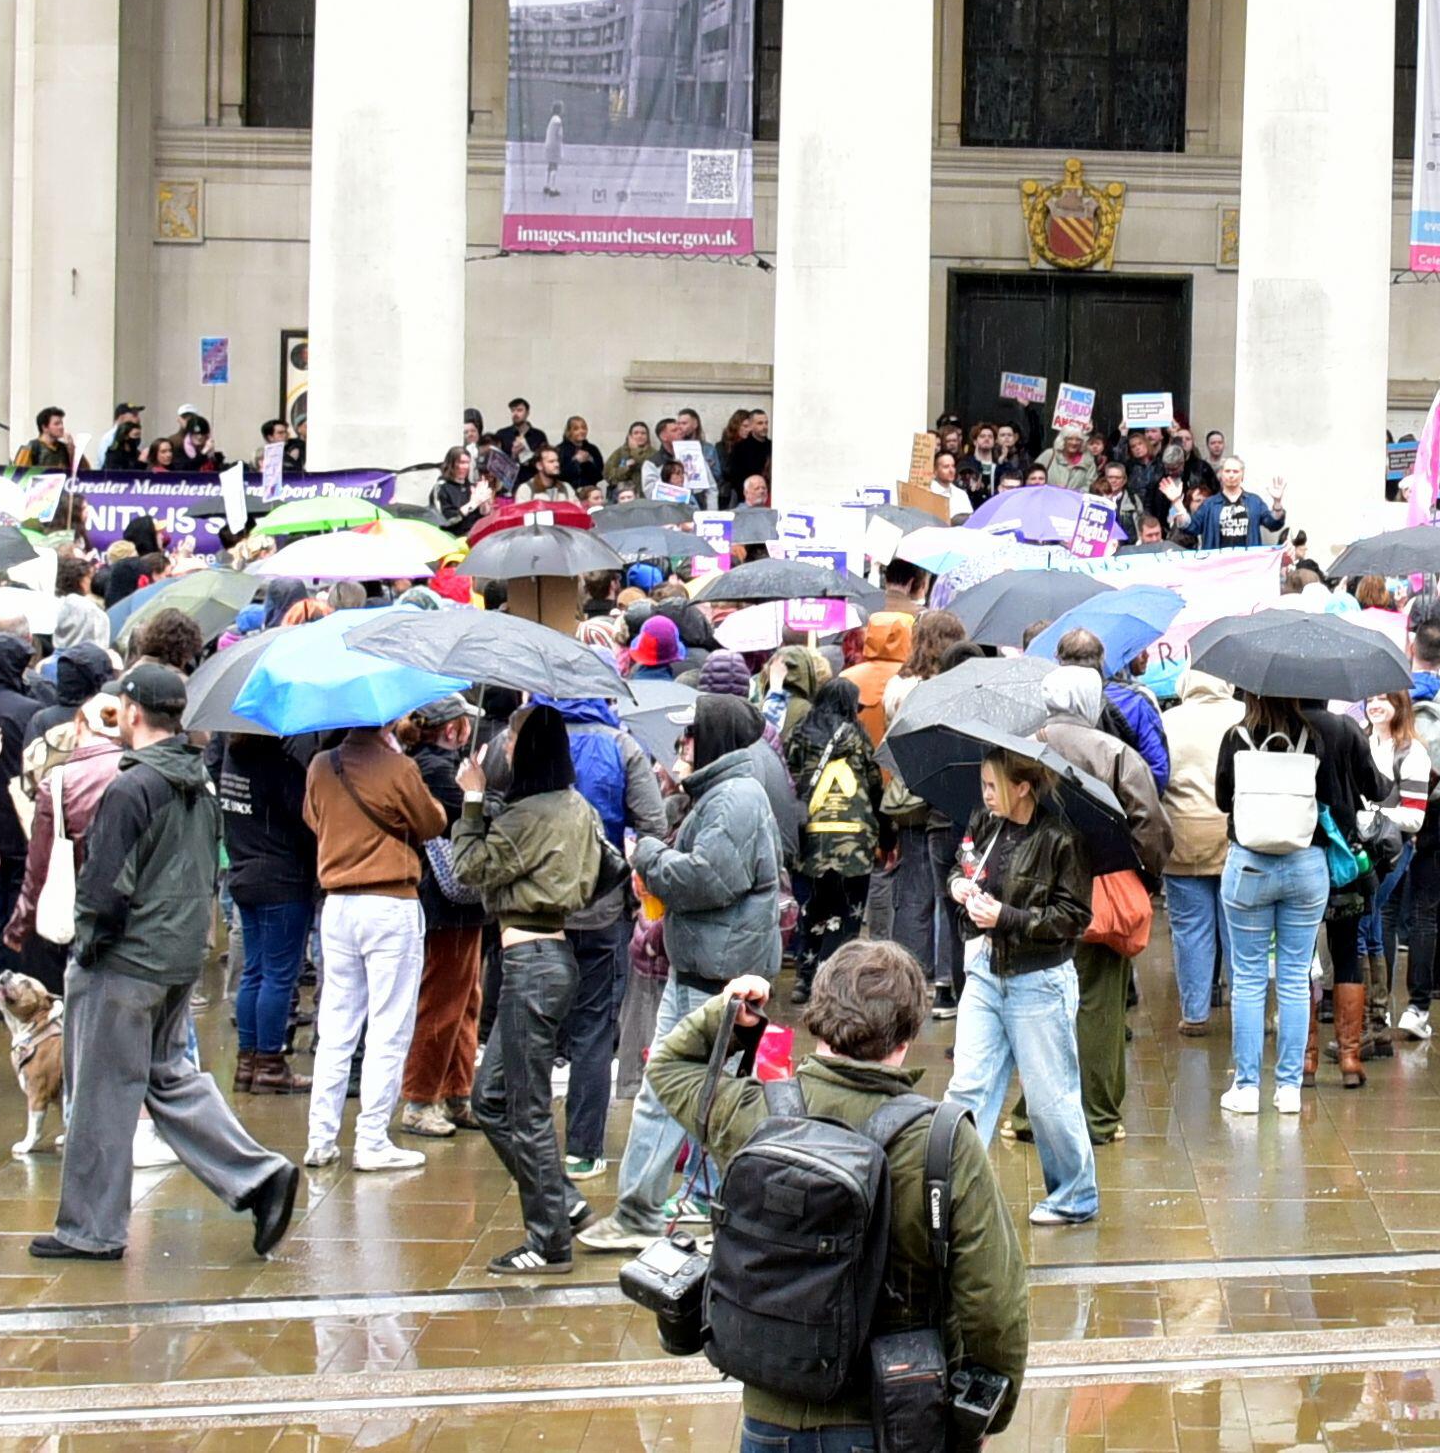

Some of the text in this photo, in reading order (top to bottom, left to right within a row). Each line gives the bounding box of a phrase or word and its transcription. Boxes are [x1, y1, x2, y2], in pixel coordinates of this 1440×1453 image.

[517, 225, 737, 249] images.manchester.gov.uk
[65, 477, 128, 495] Greater
[131, 479, 223, 497] Mancheste
[245, 482, 318, 501] raport
[86, 505, 159, 532] NITY
[167, 507, 196, 534] IS
[1083, 501, 1108, 523] Trans
[1078, 519, 1109, 543] Rights
[1071, 537, 1093, 556] Now
[788, 598, 828, 621] Now
[931, 1187, 941, 1229] Canon
